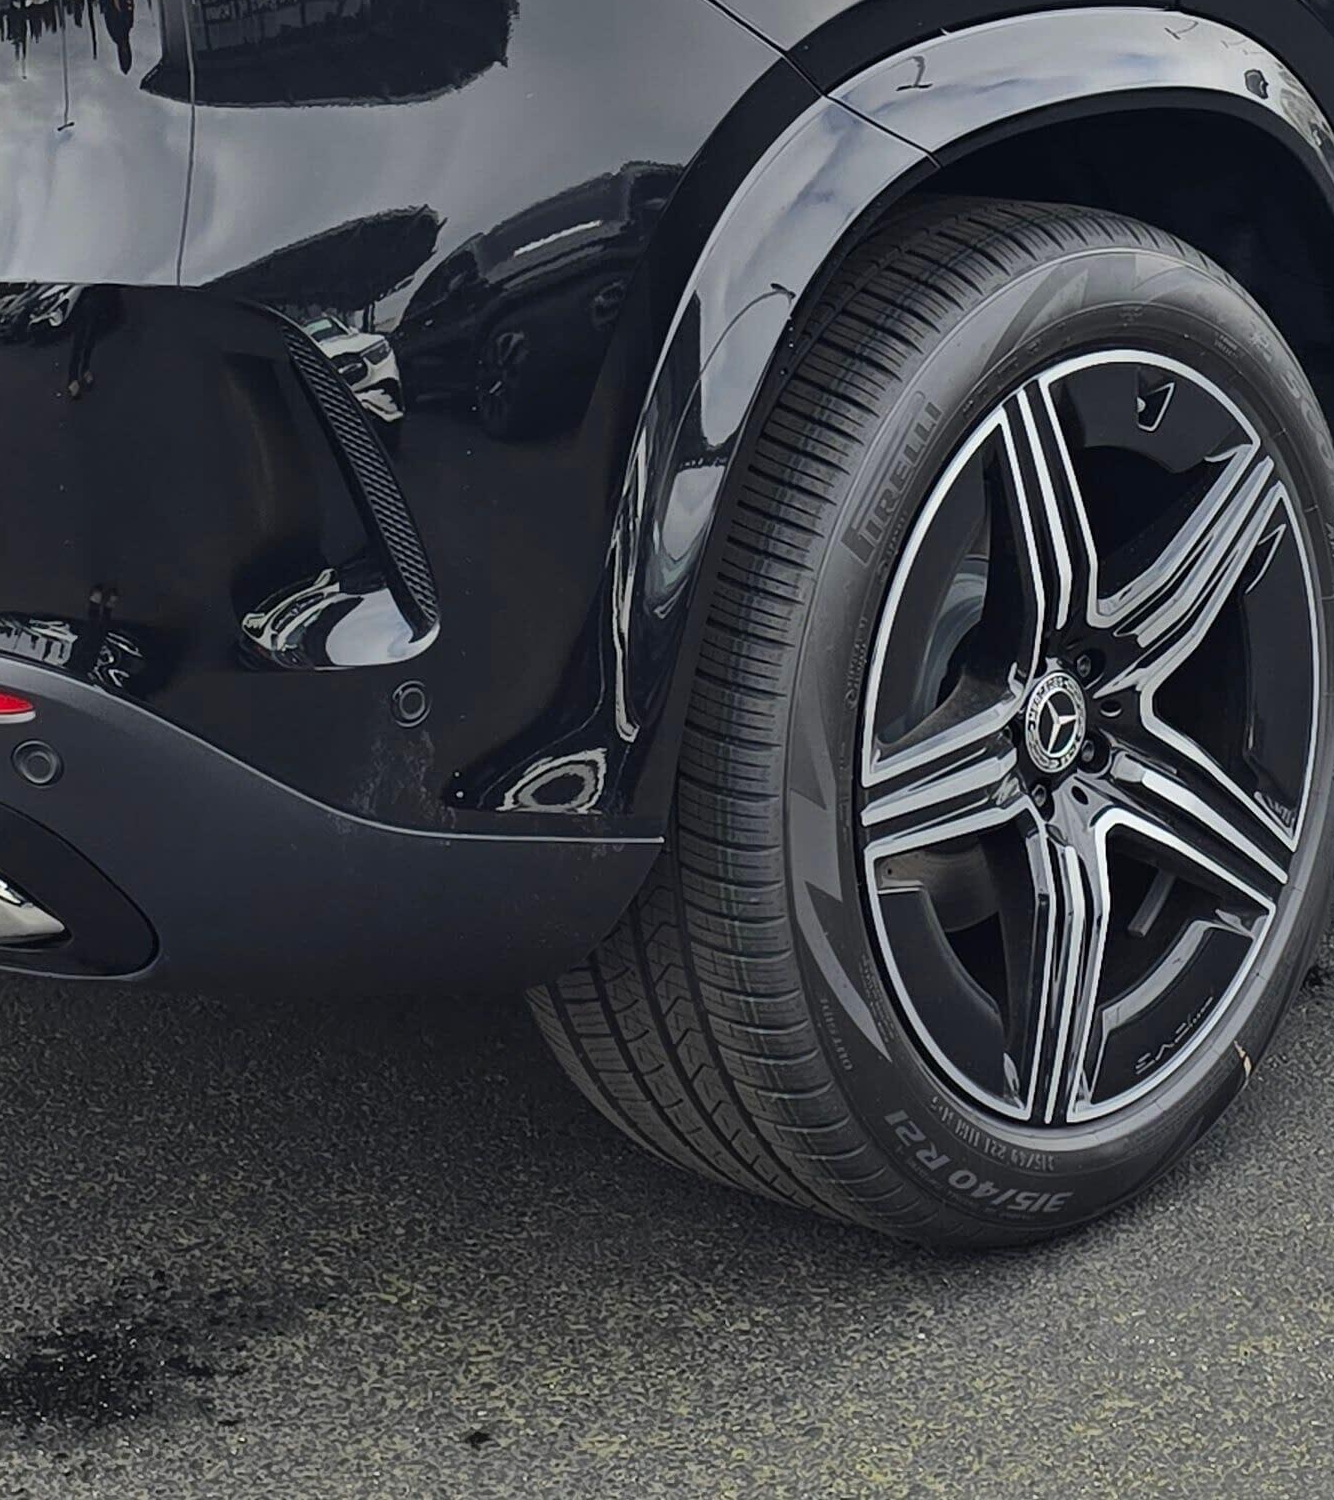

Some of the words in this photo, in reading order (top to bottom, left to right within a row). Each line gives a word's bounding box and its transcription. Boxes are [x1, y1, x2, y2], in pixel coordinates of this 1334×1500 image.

[840, 391, 942, 576] PIRELLI
[884, 1109, 951, 1172] R21
[948, 1169, 1073, 1213] 315/40
